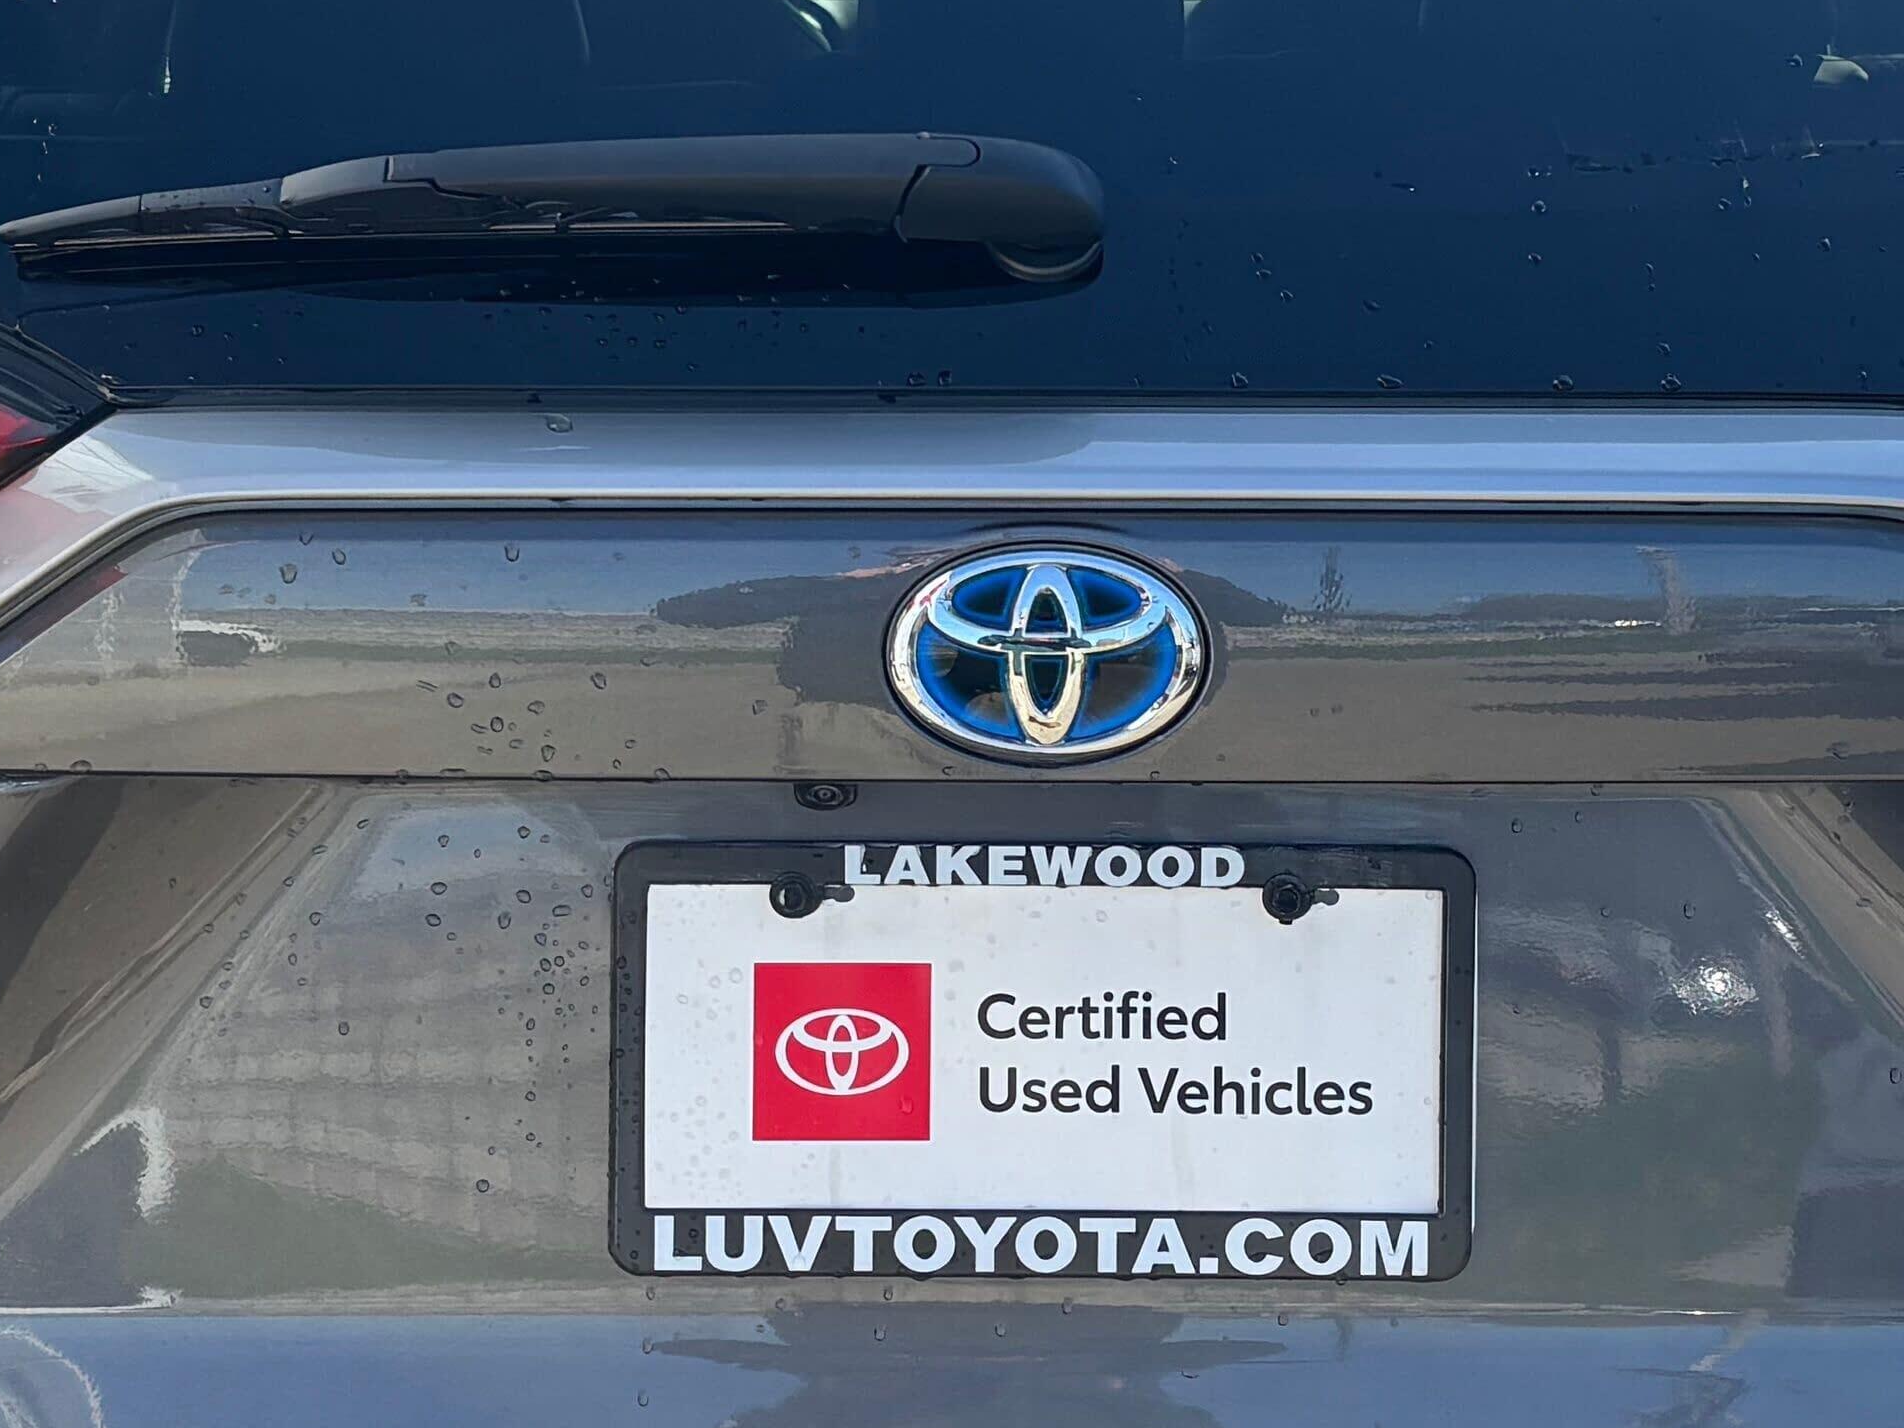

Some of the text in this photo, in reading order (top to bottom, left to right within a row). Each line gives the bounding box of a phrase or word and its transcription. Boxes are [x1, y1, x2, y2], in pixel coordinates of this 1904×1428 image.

[844, 845, 1247, 888] LAKEWOOD
[977, 990, 1227, 1041] Certified
[978, 1065, 1374, 1116] Used Vehicles
[652, 1215, 1431, 1277] LUVTOYOTA.COM
